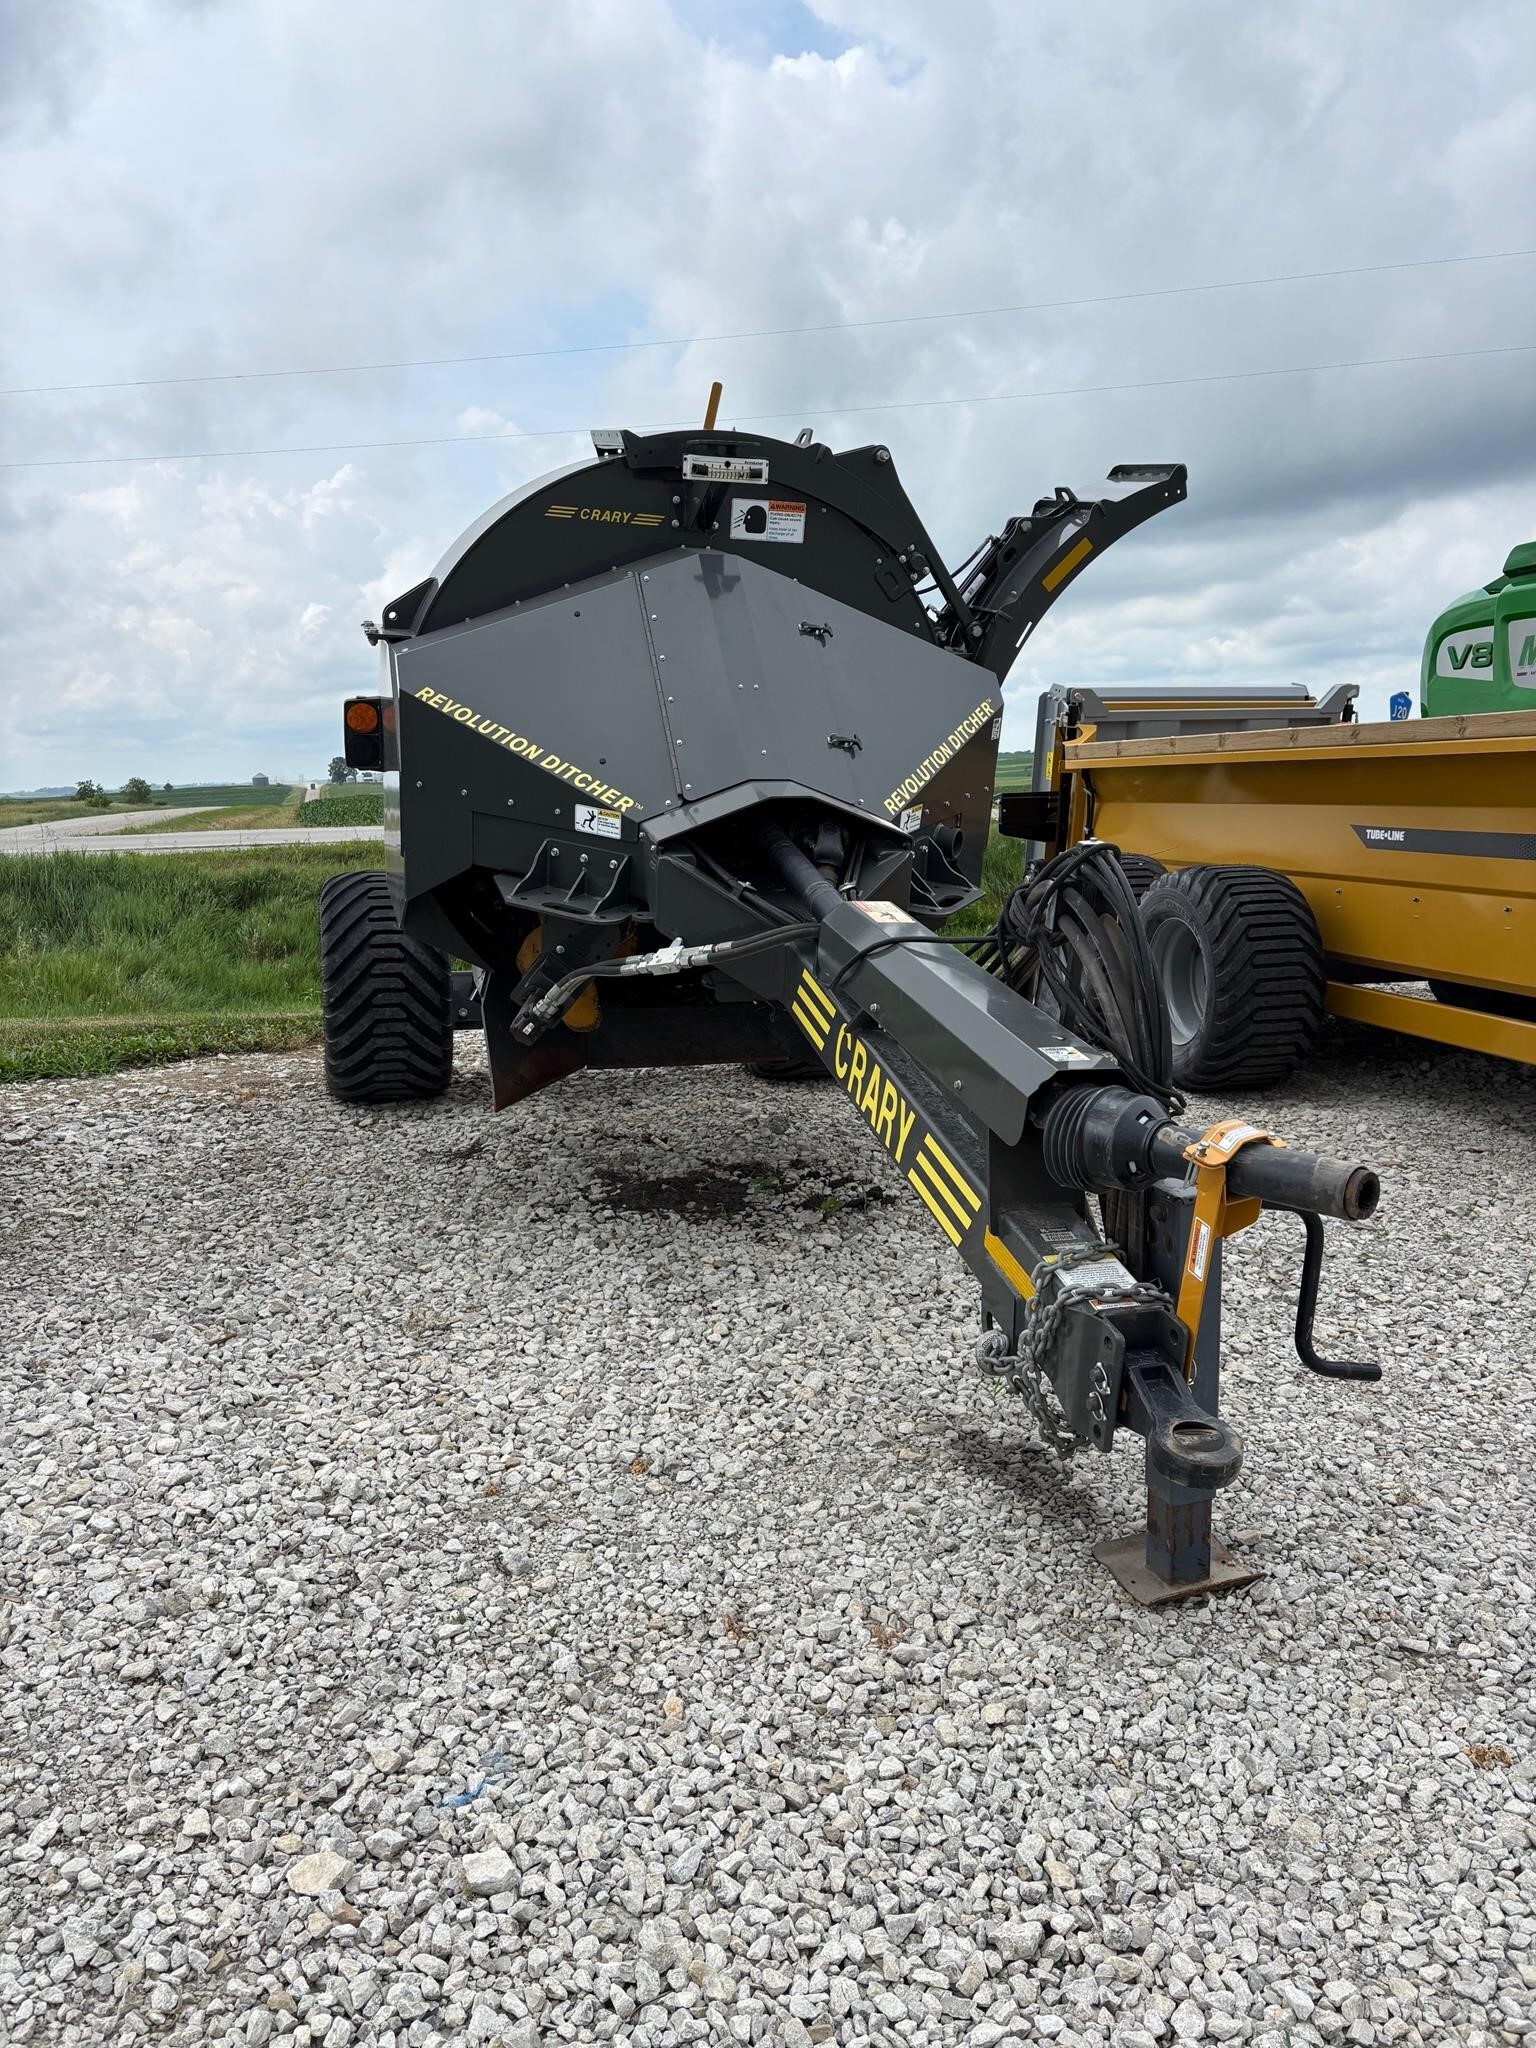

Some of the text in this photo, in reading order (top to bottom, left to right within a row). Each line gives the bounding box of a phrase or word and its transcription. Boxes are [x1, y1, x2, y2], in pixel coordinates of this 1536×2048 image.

[580, 508, 632, 523] CRARY
[775, 503, 804, 512] WARNING
[1447, 642, 1493, 670] V8
[1392, 705, 1407, 720] J20
[414, 687, 544, 761] REVOLUTION
[540, 754, 635, 812] DITCHER
[884, 742, 953, 816] REVOLUTION
[948, 702, 995, 750] DITCHER
[835, 1022, 916, 1163] CRARY
